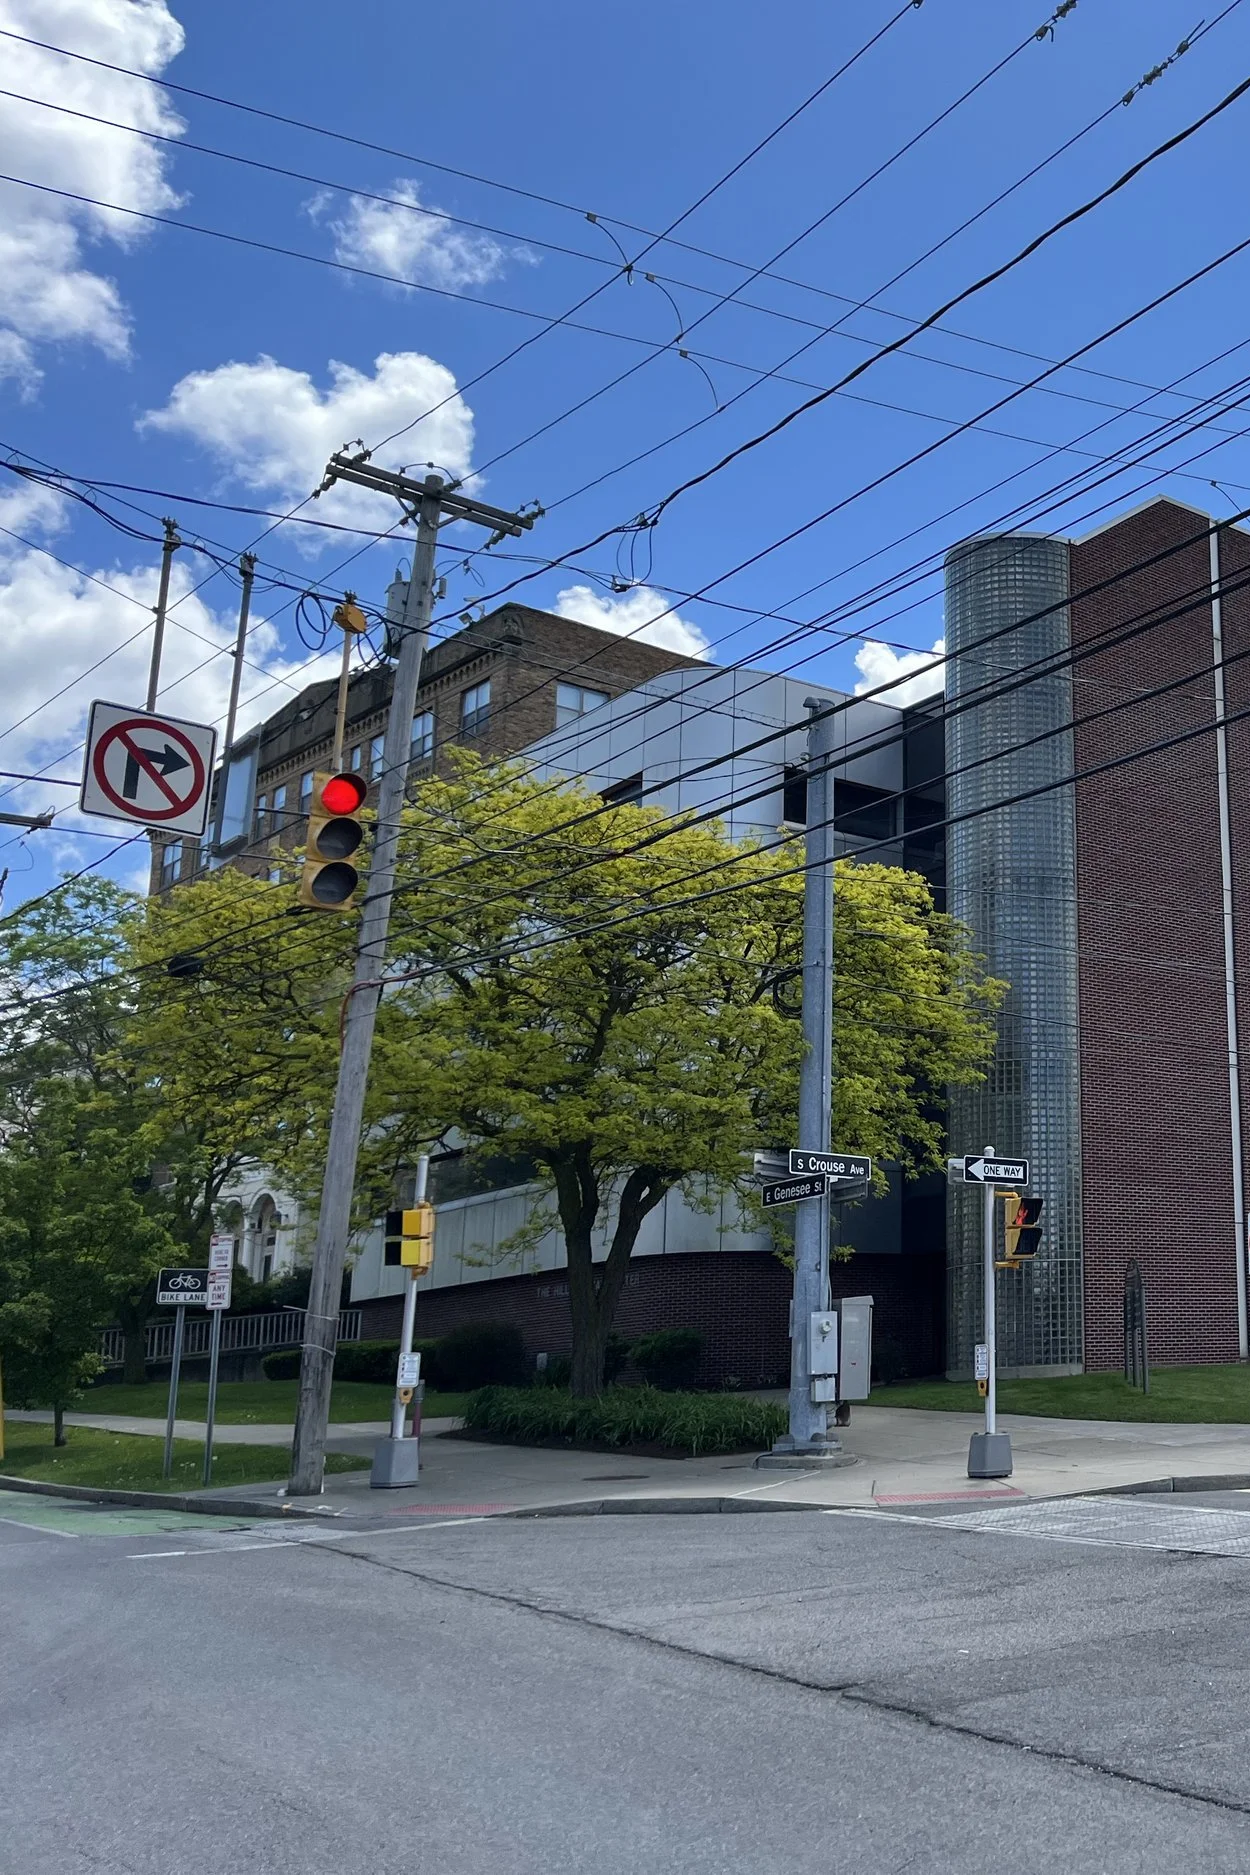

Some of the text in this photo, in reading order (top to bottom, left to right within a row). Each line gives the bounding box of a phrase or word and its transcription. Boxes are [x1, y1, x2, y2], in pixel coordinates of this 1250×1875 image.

[797, 1157, 865, 1175] S Crouse Ave
[983, 1165, 1021, 1177] ONE WAY
[766, 1181, 822, 1203] E Genesee St
[161, 1293, 205, 1301] BIKE LANE
